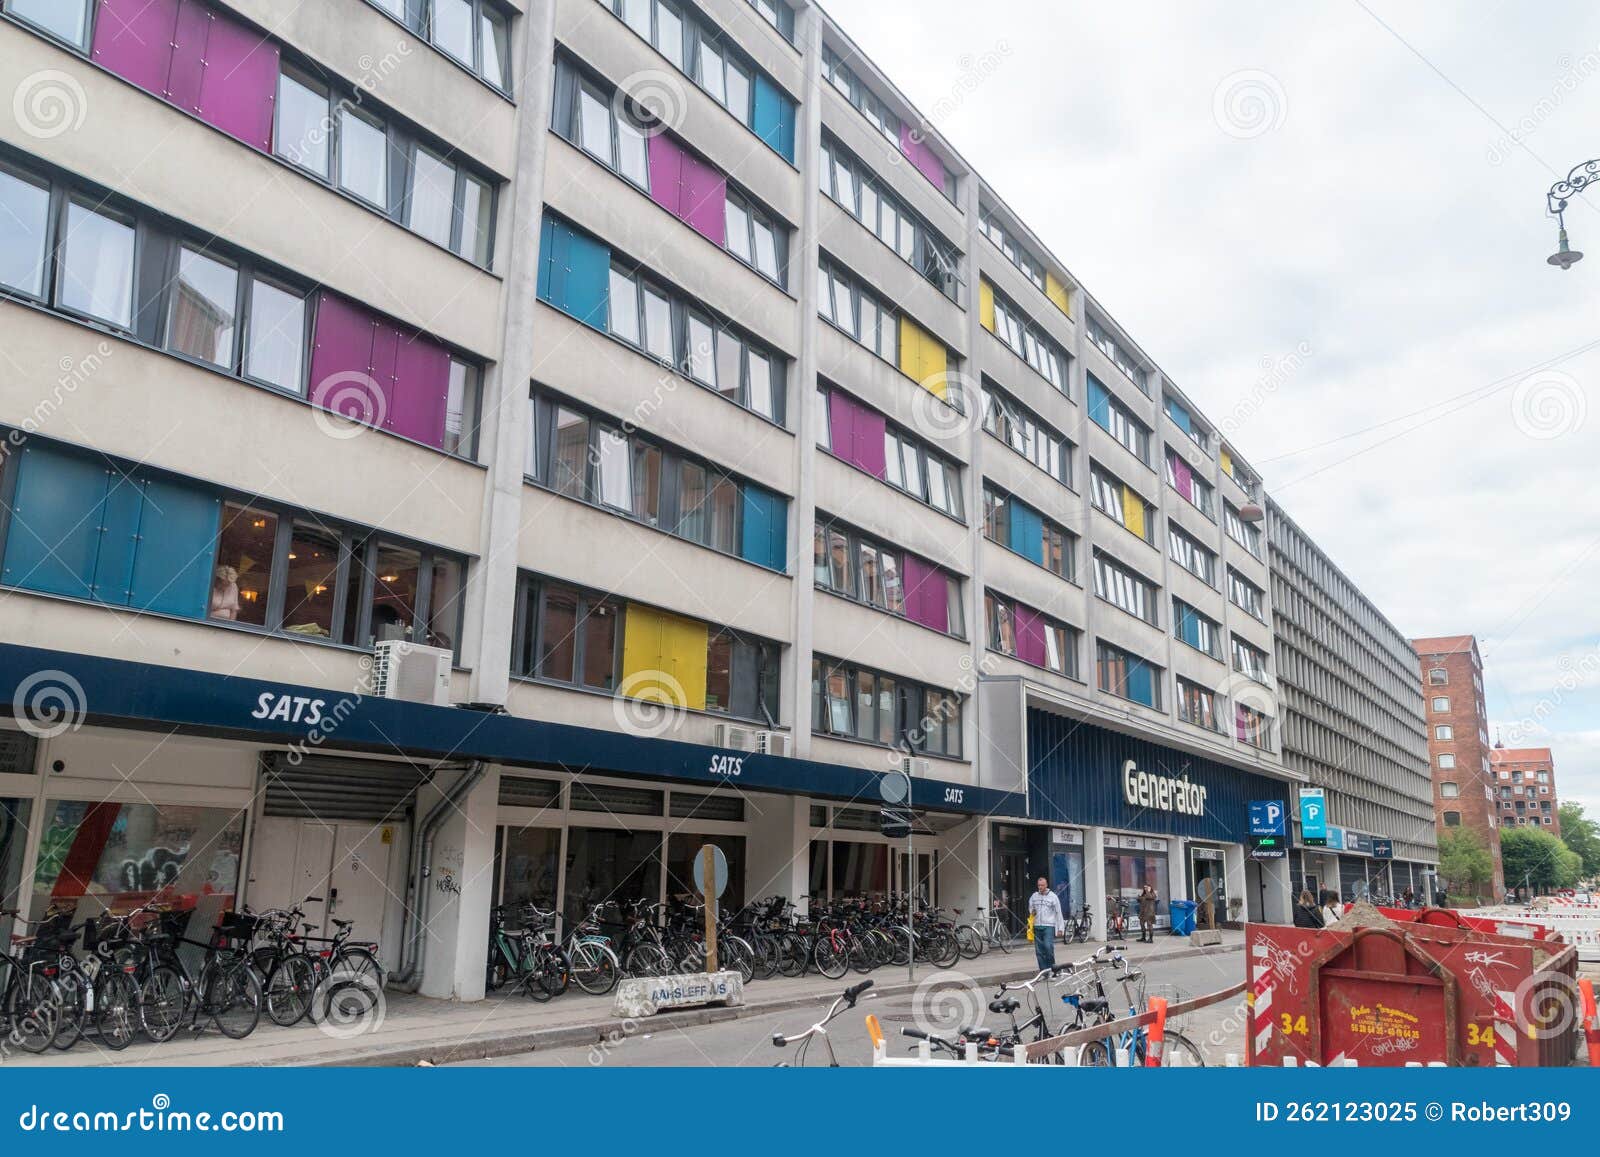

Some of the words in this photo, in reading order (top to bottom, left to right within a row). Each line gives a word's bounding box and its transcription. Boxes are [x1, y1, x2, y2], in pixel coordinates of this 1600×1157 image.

[251, 692, 326, 725] SATS
[709, 754, 743, 776] SATS
[944, 787, 964, 804] SATS
[1122, 759, 1207, 817] Generator
[1267, 805, 1280, 825] P
[1308, 806, 1319, 820] P
[1251, 850, 1284, 858] Generator
[1281, 1012, 1309, 1036] 34
[1467, 1023, 1497, 1048] 34
